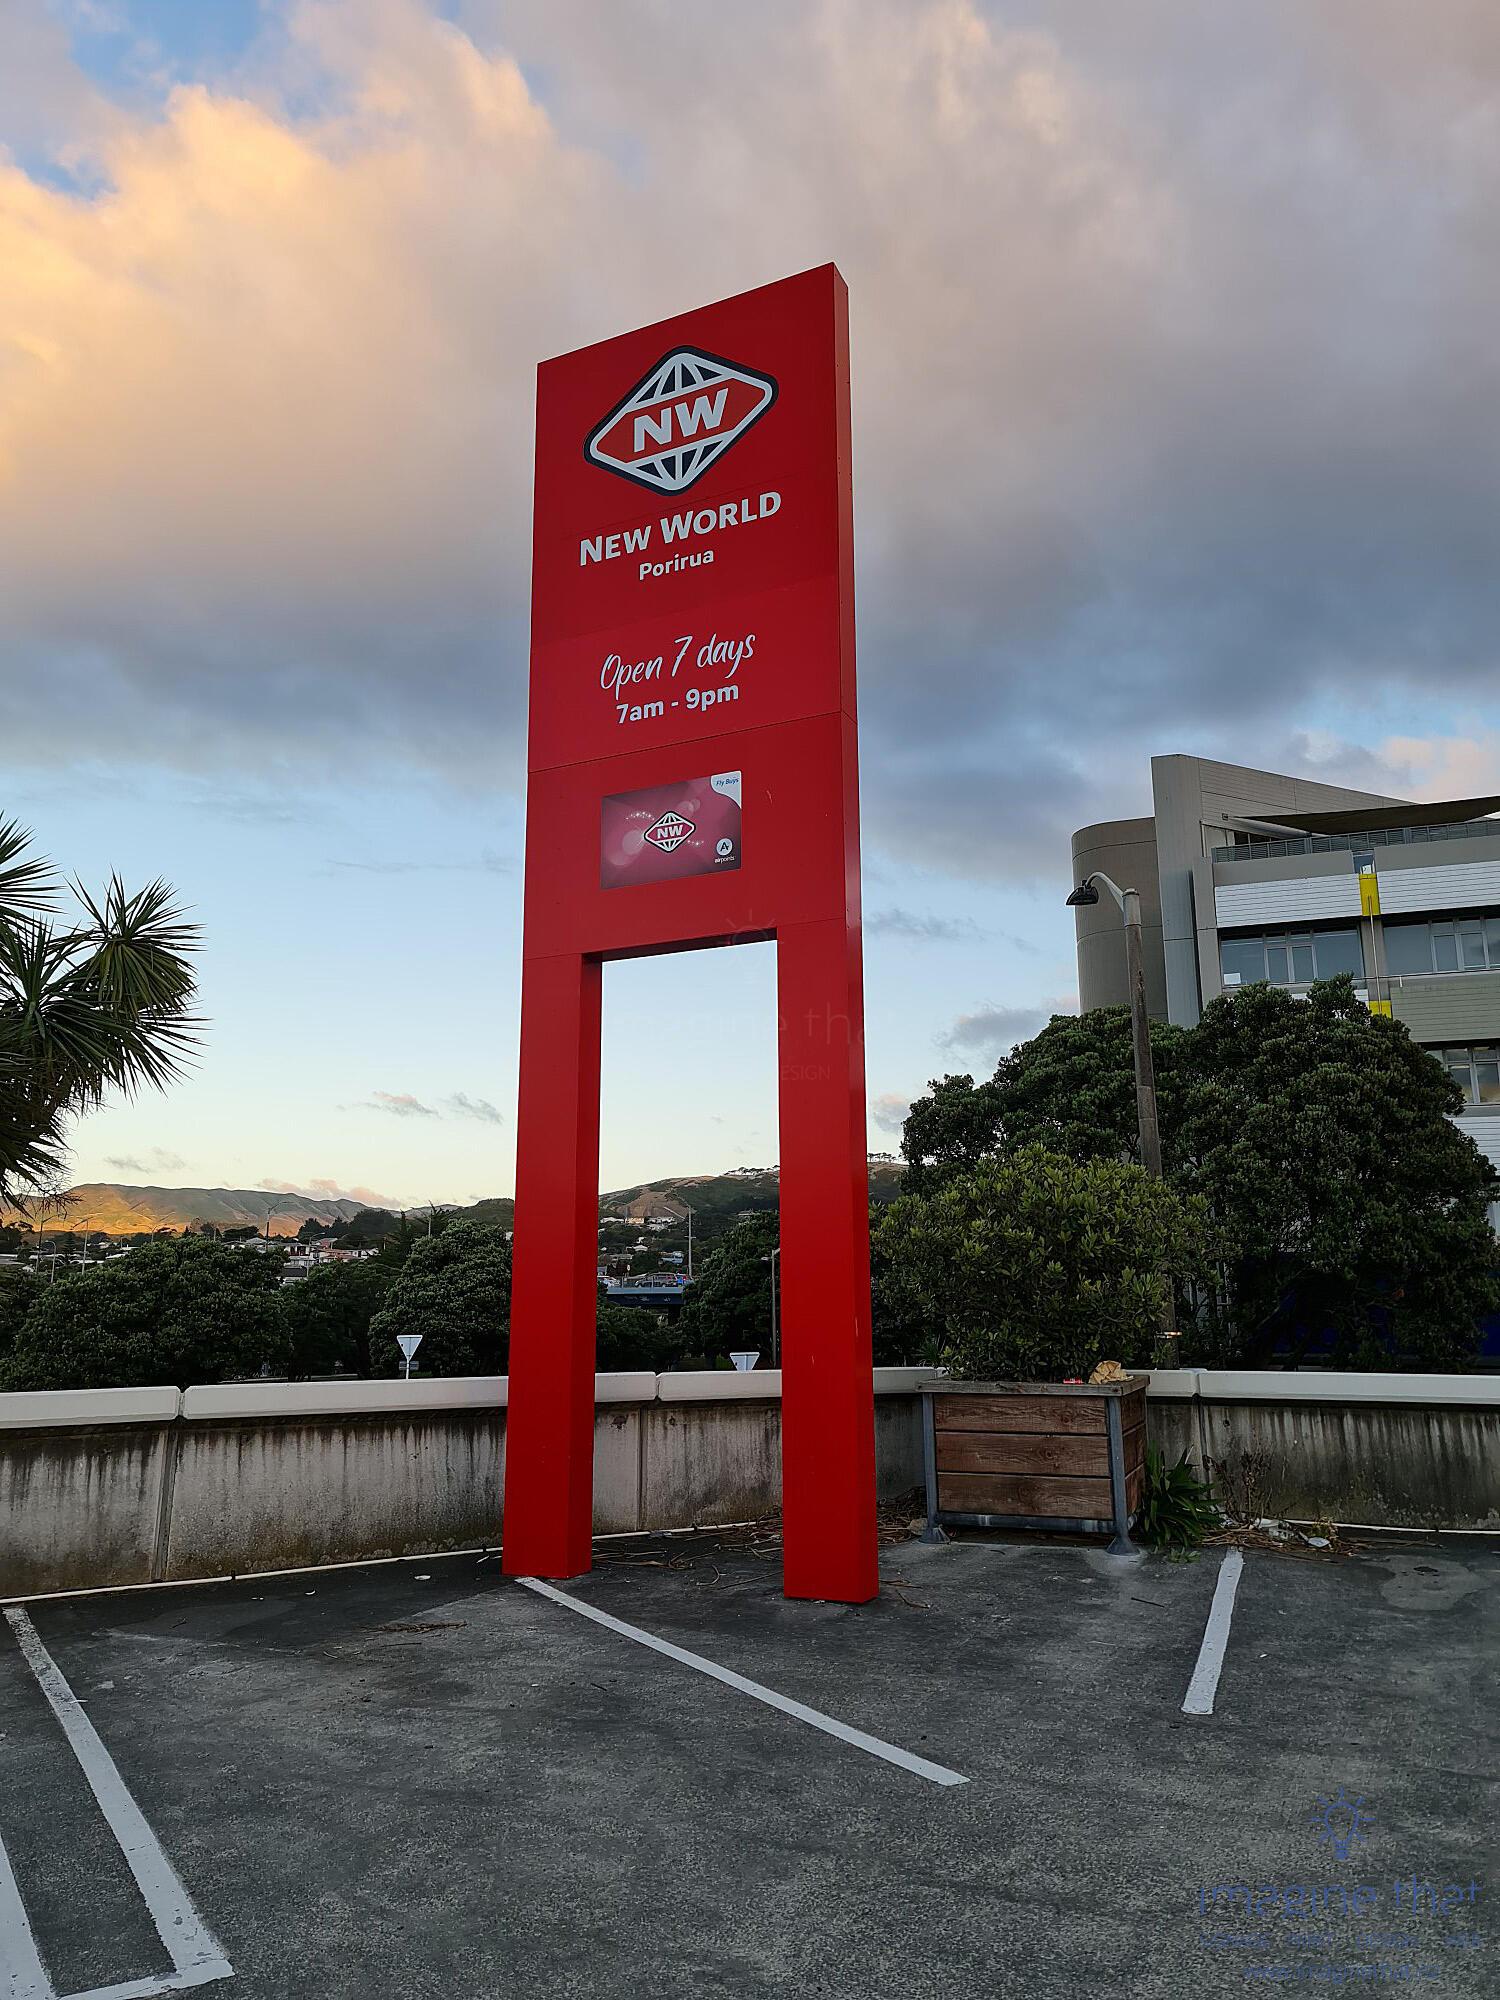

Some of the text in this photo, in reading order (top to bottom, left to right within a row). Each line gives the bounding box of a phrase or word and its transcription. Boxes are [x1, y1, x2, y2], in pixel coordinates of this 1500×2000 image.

[633, 387, 729, 453] NW
[579, 490, 783, 566] NEW WORLD
[638, 549, 714, 580] Porirua
[600, 633, 756, 700] Open 7 days
[616, 699, 665, 724] 7am
[685, 683, 739, 711] 9pm
[657, 824, 684, 839] NW
